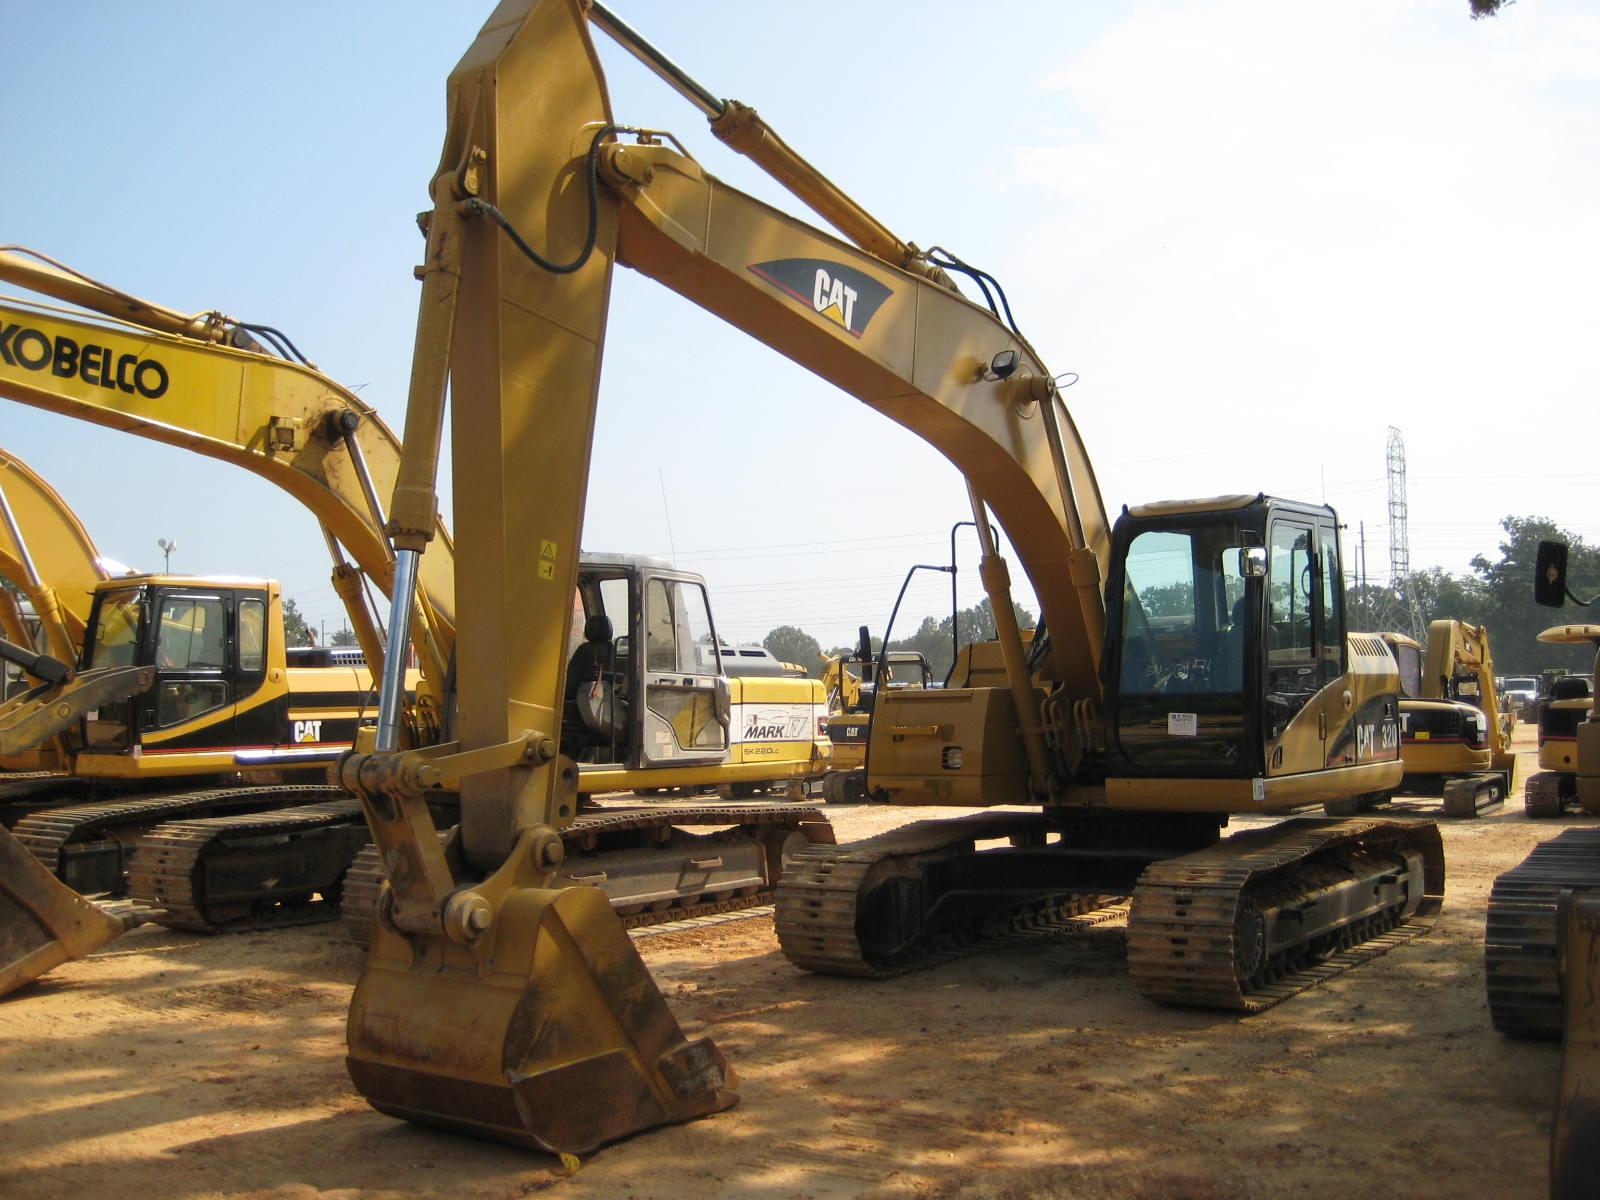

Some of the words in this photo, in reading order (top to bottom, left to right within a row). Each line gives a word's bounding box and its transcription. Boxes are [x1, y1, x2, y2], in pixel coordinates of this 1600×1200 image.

[813, 268, 858, 331] CAT
[0, 320, 169, 399] KOBELCO
[294, 720, 322, 743] CAT
[744, 725, 785, 739] MARK
[846, 727, 859, 737] CAT
[1357, 724, 1375, 759] CAT
